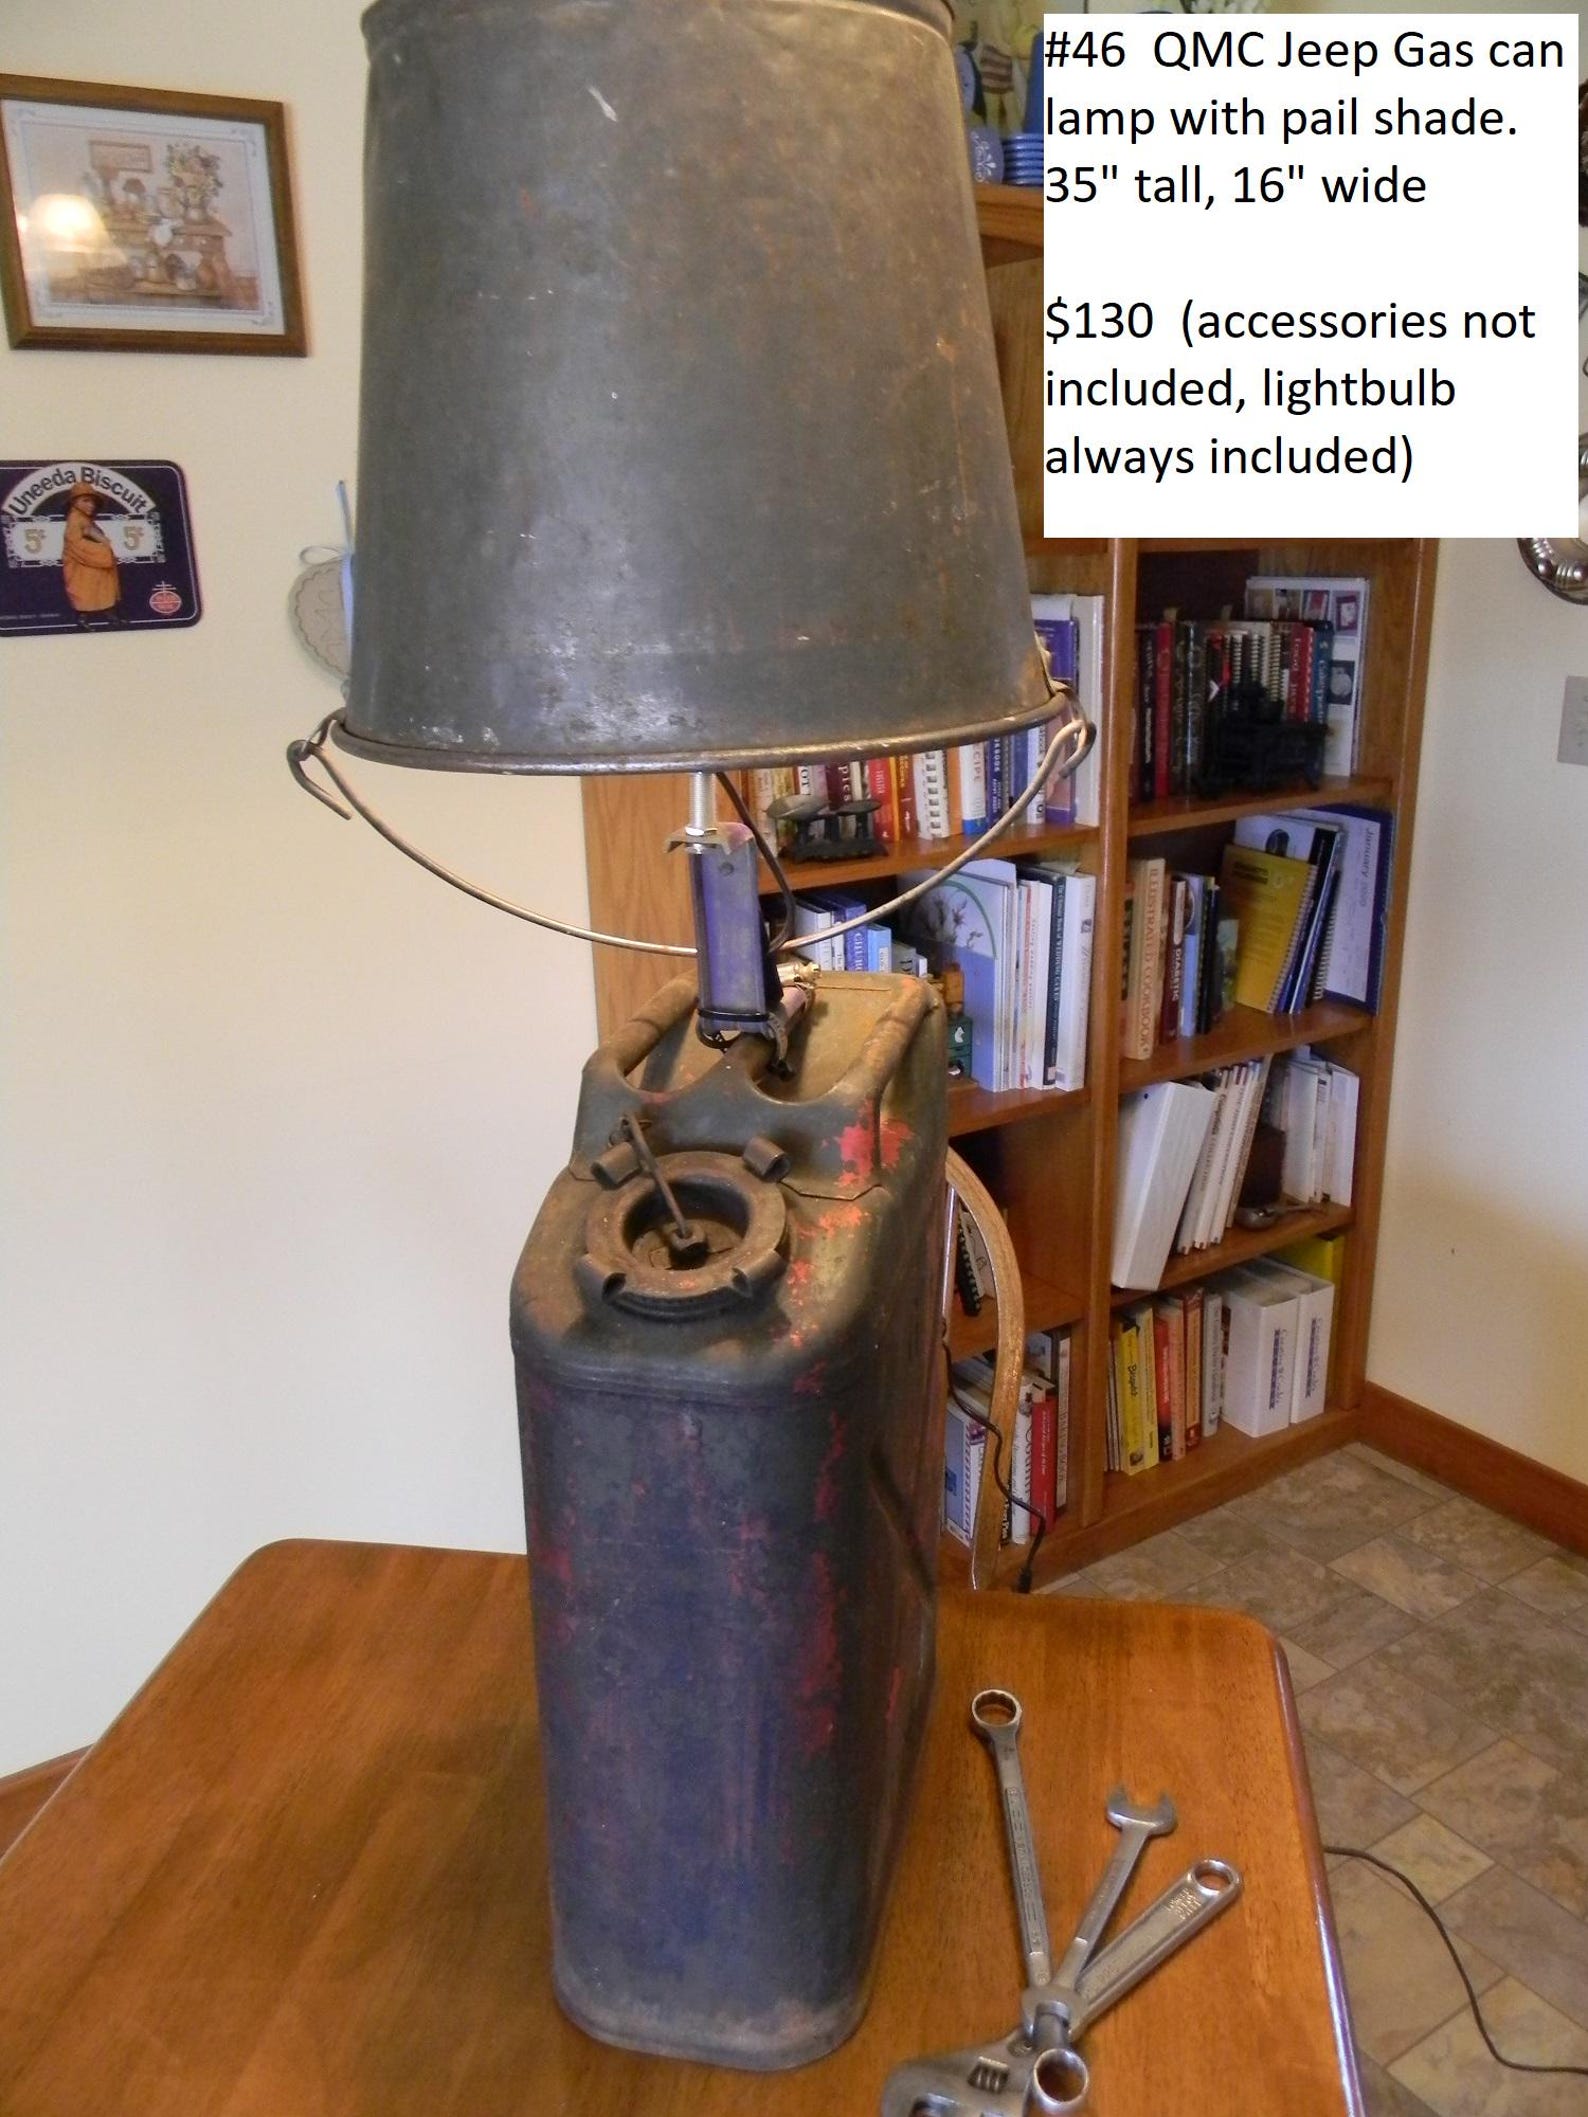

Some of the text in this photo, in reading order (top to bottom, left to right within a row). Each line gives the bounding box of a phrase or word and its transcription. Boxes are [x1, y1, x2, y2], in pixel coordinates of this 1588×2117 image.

[9, 466, 148, 516] Uneeda Biscuit
[1361, 828, 1375, 878] January
[1139, 868, 1158, 1047] ILLUSTRATED COOKBOOK
[1171, 947, 1183, 1002] DIABETIC
